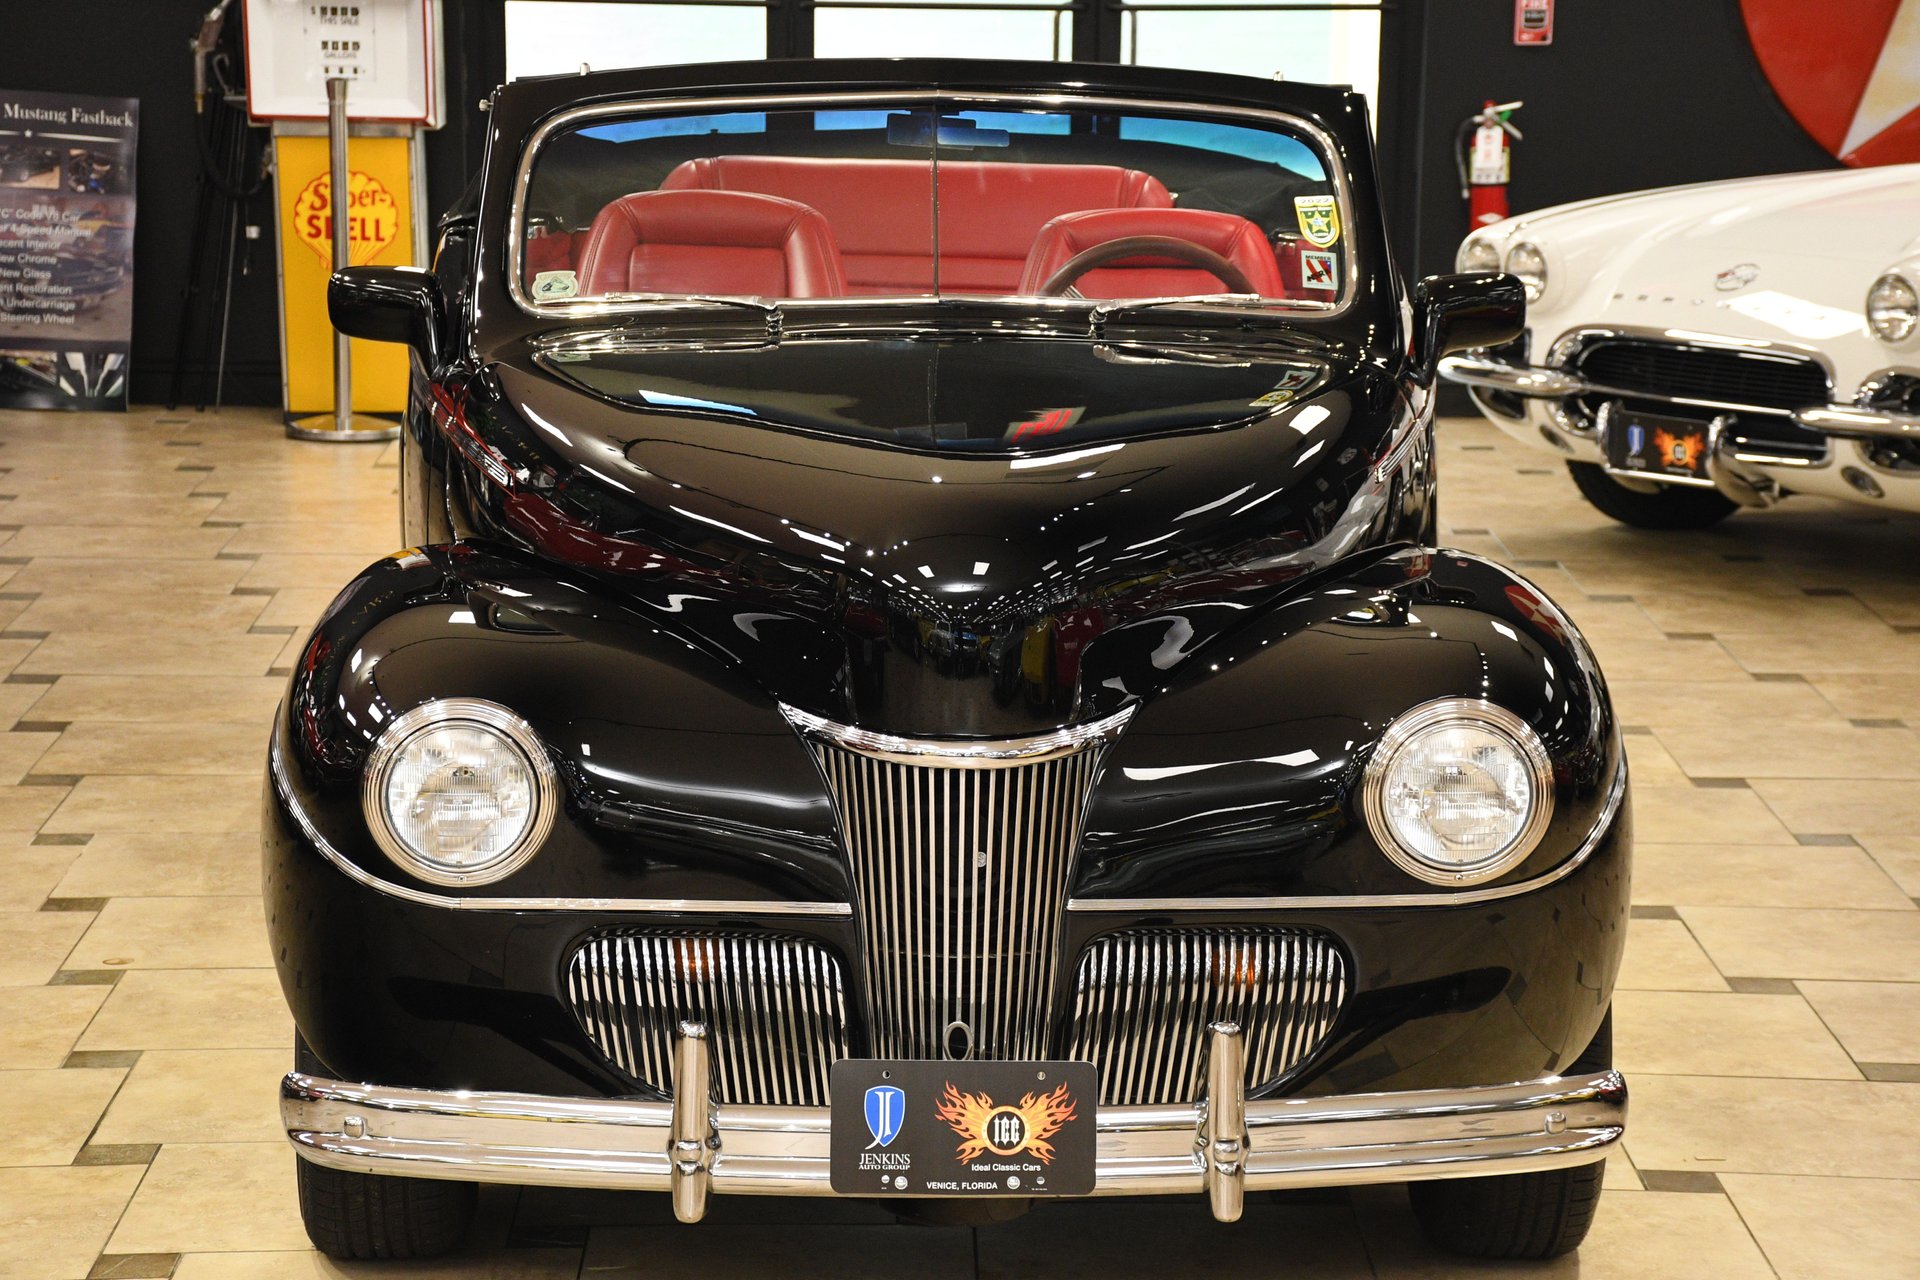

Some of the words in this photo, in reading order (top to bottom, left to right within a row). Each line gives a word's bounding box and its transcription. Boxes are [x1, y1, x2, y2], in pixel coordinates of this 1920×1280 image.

[4, 103, 67, 124] Mustang
[71, 107, 133, 127] Fastback
[26, 239, 61, 251] Interior
[17, 253, 57, 265] Chrome
[23, 267, 52, 279] Glass
[15, 282, 73, 295] Restoration
[6, 298, 76, 312] Undercarriage
[42, 313, 75, 325] Wheel
[859, 1153, 911, 1165] JENKINS
[971, 1163, 991, 1171] Ideal
[992, 1163, 1021, 1171] Classic
[1022, 1163, 1041, 1171] Cars
[926, 1182, 960, 1191] VENICE,
[961, 1182, 998, 1190] FLORIDA
